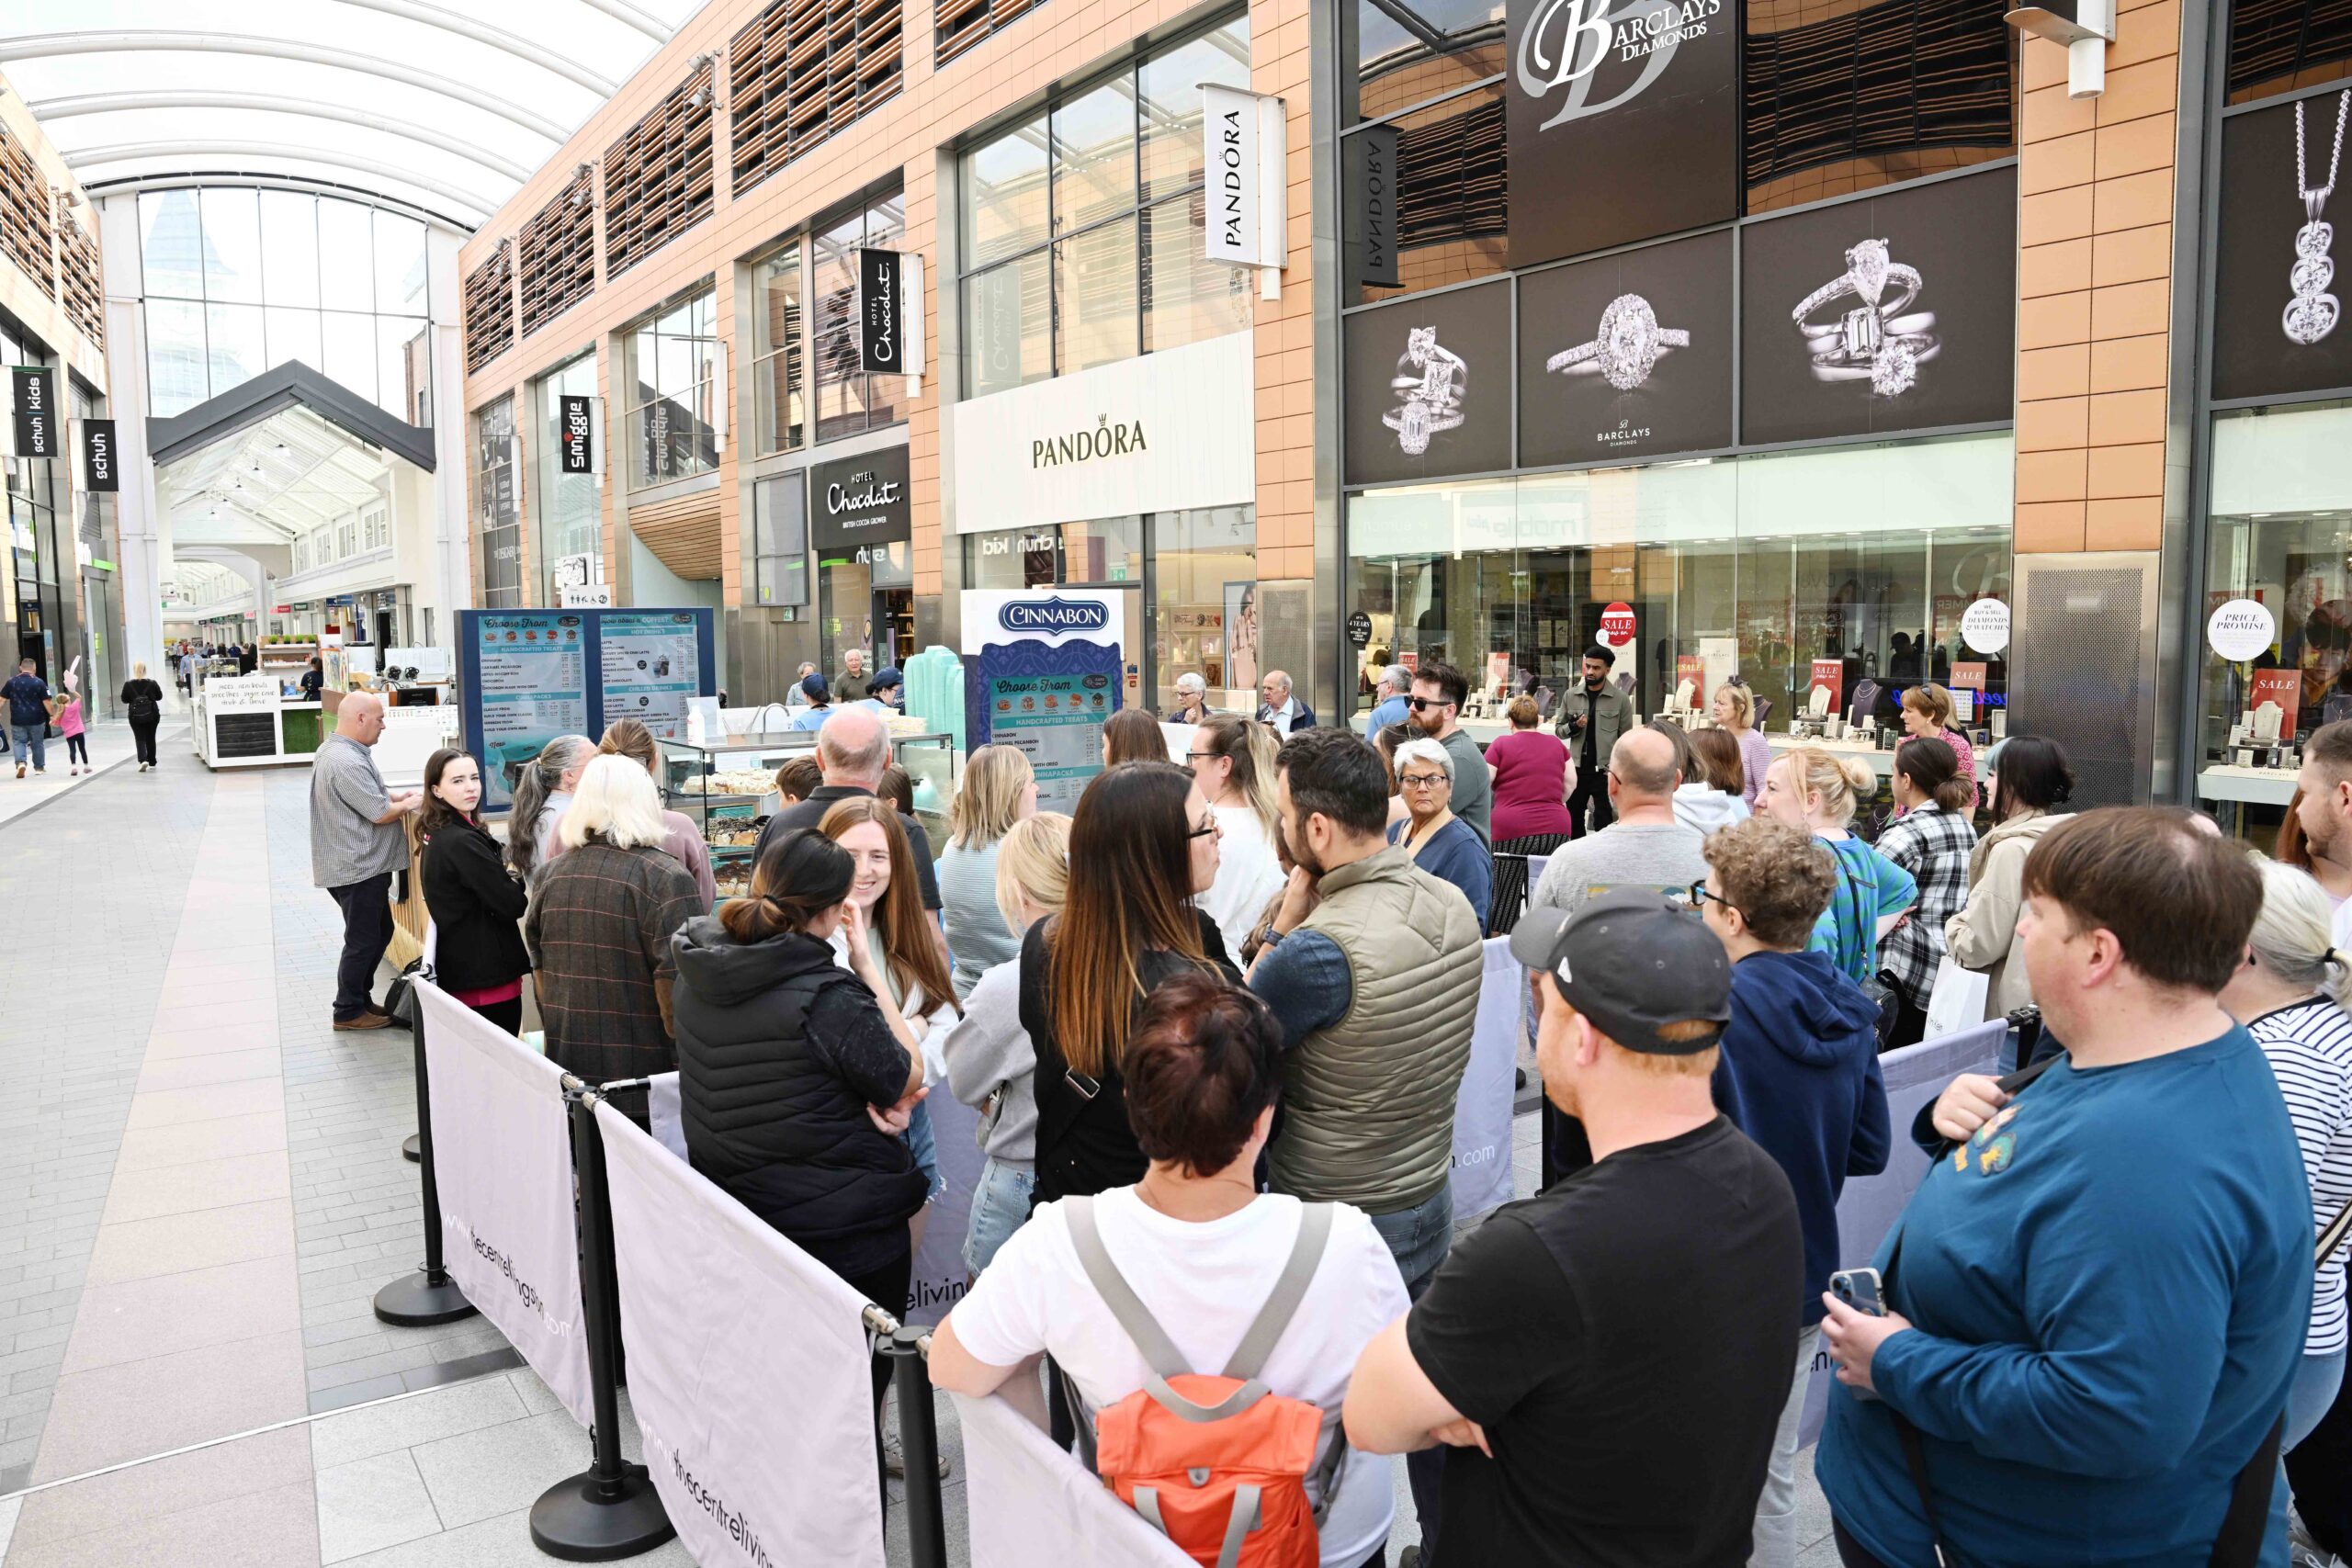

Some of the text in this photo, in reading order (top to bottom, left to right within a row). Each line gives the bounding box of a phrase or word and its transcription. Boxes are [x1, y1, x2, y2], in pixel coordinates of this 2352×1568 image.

[1621, 21, 1708, 62] DIAMONDS
[1223, 110, 1241, 247] PANDORA
[28, 377, 44, 453] schuh kids
[564, 401, 588, 468] smiggle
[1597, 428, 1651, 442] BARCLAYS
[1033, 420, 1147, 469] PANDORA
[90, 433, 108, 479] schuh
[851, 471, 873, 484] HOTEL
[842, 515, 888, 529] BRITISH COCOA GROWER
[1010, 605, 1102, 625] CINNABON
[2225, 614, 2259, 622] PRICE
[484, 618, 519, 628] Choose
[521, 617, 548, 627] From
[1603, 619, 1632, 630] SALE
[2216, 622, 2267, 630] PROMISE
[1680, 662, 1702, 671] SALE
[1815, 666, 1838, 674] SALE
[1954, 671, 1982, 680] SALE
[997, 678, 1072, 694] Choose From
[2258, 679, 2295, 690] SALE
[1015, 716, 1064, 726] HANDCRAFTED
[1035, 770, 1074, 779] INNAPACKS
